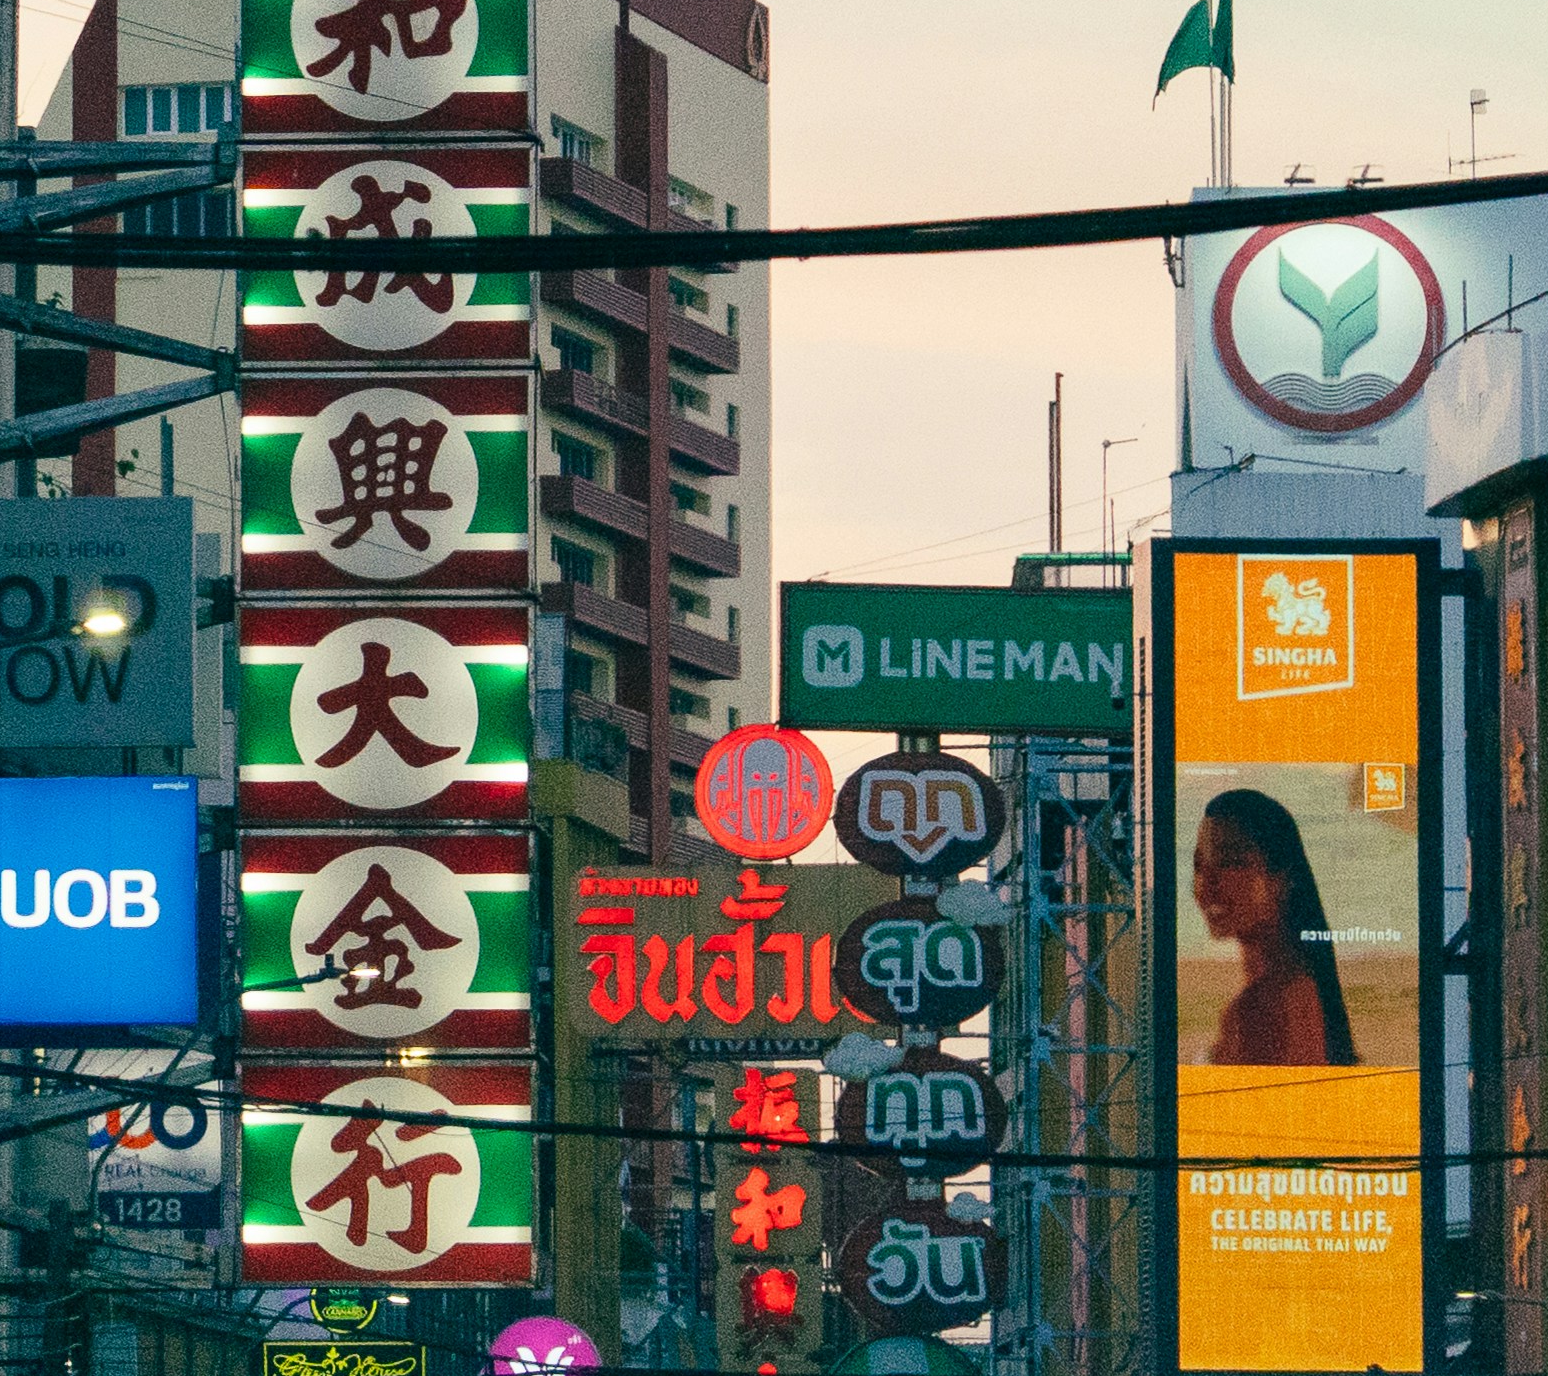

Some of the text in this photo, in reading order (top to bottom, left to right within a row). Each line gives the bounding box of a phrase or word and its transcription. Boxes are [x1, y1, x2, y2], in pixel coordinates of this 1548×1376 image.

[67, 540, 127, 560] HENG
[1253, 646, 1337, 667] SINGHA
[0, 868, 161, 929] UOB
[114, 1197, 182, 1223] 1428
[1210, 1209, 1393, 1235] CELEBRATE LIFE,
[1210, 1236, 1388, 1252] THE ORIGINAL THAI WAY
